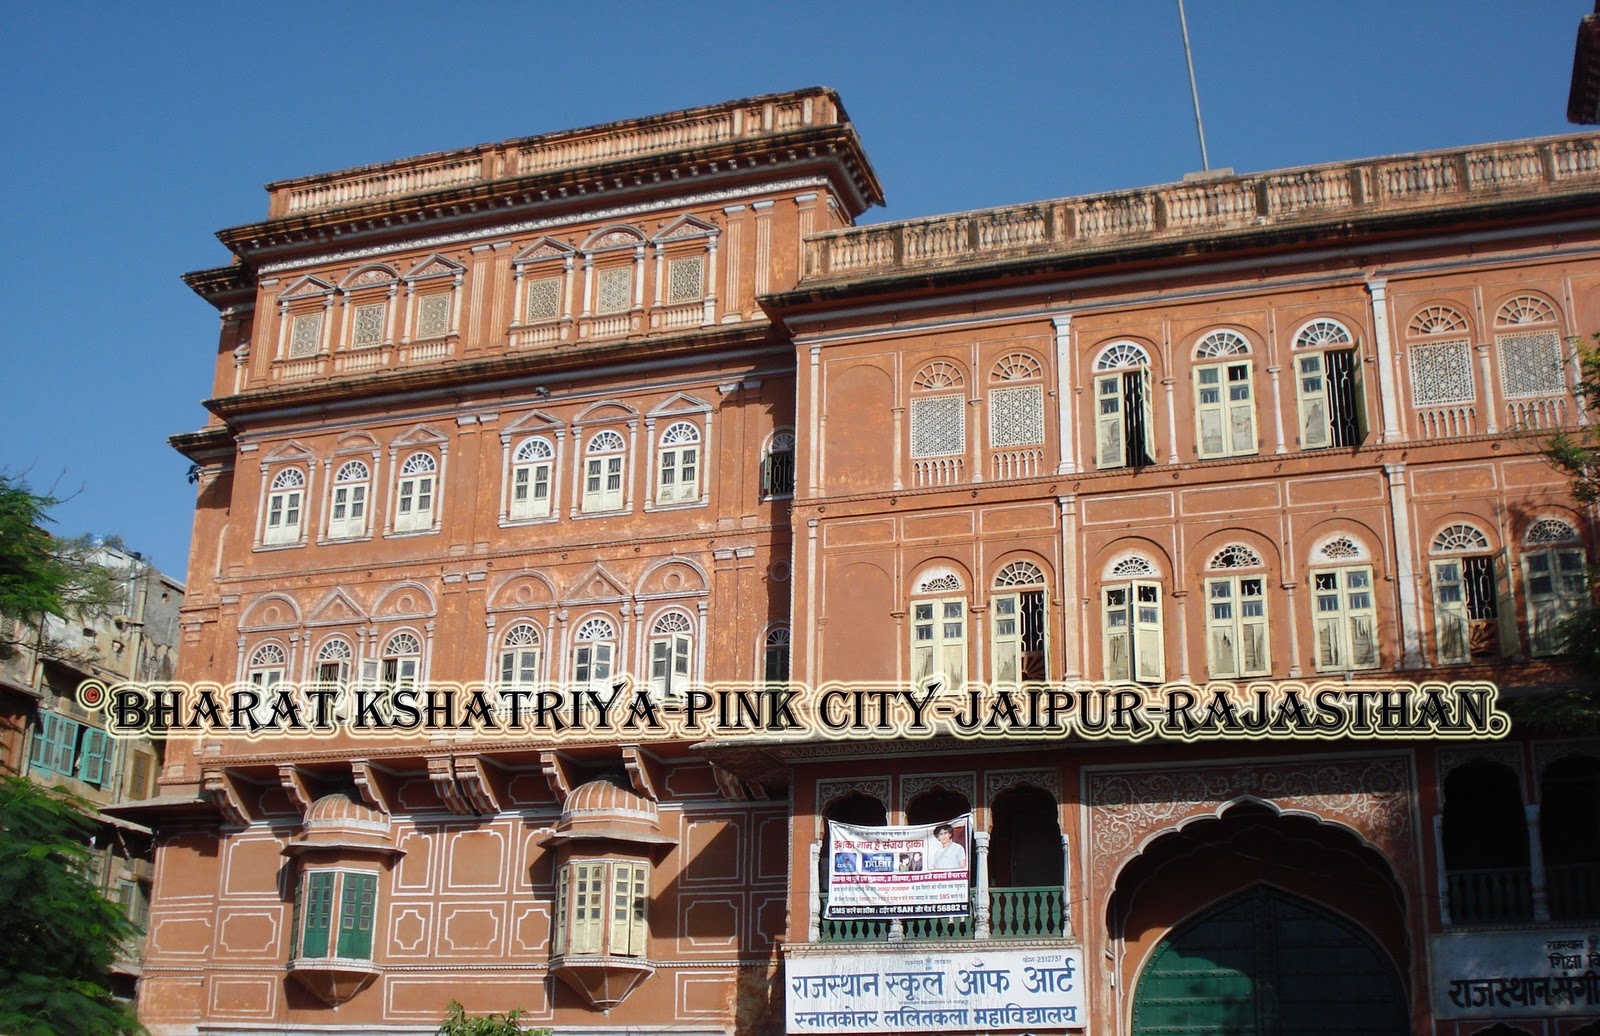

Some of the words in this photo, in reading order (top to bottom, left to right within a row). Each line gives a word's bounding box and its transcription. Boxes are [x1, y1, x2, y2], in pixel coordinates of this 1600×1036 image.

[857, 840, 872, 850] नाम
[875, 838, 880, 851] है
[883, 838, 903, 850] संजय
[864, 860, 892, 869] TALENT
[832, 907, 846, 915] SMS
[897, 905, 914, 914] SAN
[937, 904, 961, 912] 56882
[791, 973, 880, 1000] राजस्थान
[884, 971, 946, 1001] स्कूल
[954, 961, 1011, 996] ऑफ
[1021, 957, 1076, 994] आर्ट
[1447, 976, 1552, 1009] राजस्थान
[794, 1005, 880, 1030] स्नातकोत्तर
[883, 1004, 969, 1028] ललितकला
[973, 1002, 1078, 1029] महाविद्यालय
